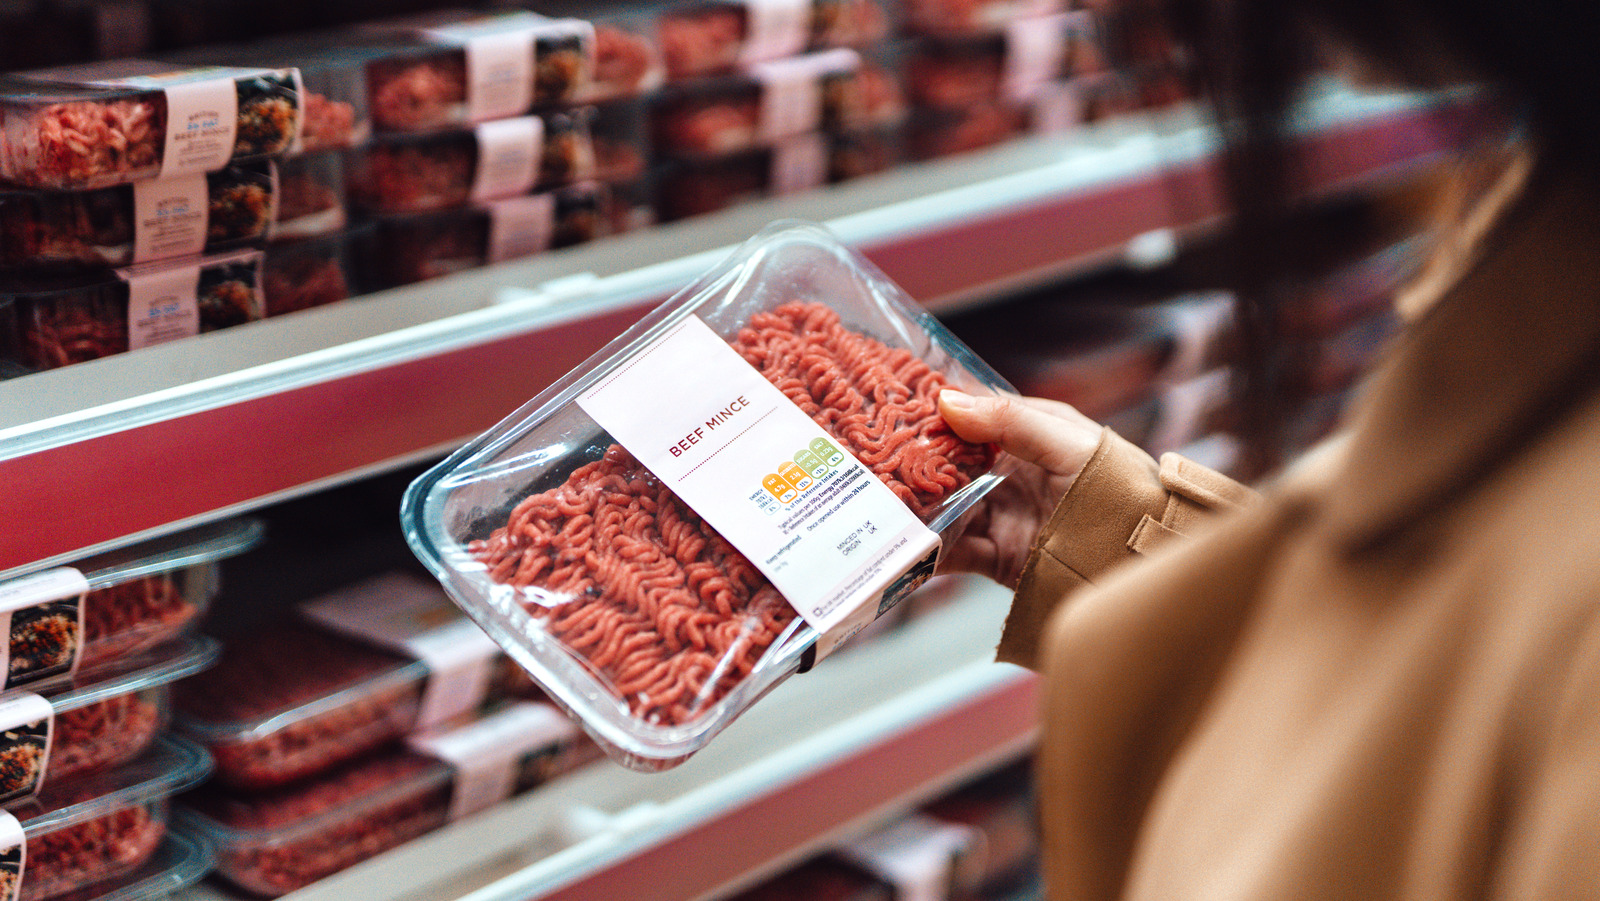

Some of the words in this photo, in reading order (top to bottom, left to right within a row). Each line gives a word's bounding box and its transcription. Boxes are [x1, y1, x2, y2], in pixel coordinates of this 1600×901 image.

[669, 427, 704, 458] BEEF
[705, 395, 750, 431] MINCE
[813, 440, 824, 450] SALT
[749, 488, 764, 501] ENERGY
[767, 477, 777, 486] FAT
[794, 497, 803, 505] the
[801, 481, 823, 499] Reference
[821, 469, 839, 484] Intakes
[818, 485, 835, 498] Energy
[806, 521, 819, 531] Once
[817, 508, 834, 523] opened
[832, 504, 841, 512] use
[840, 493, 855, 506] within
[856, 480, 871, 491] hours
[836, 532, 858, 550] MINCED
[863, 520, 872, 529] UK
[842, 539, 862, 556] ORIGIN
[867, 525, 878, 536] UK
